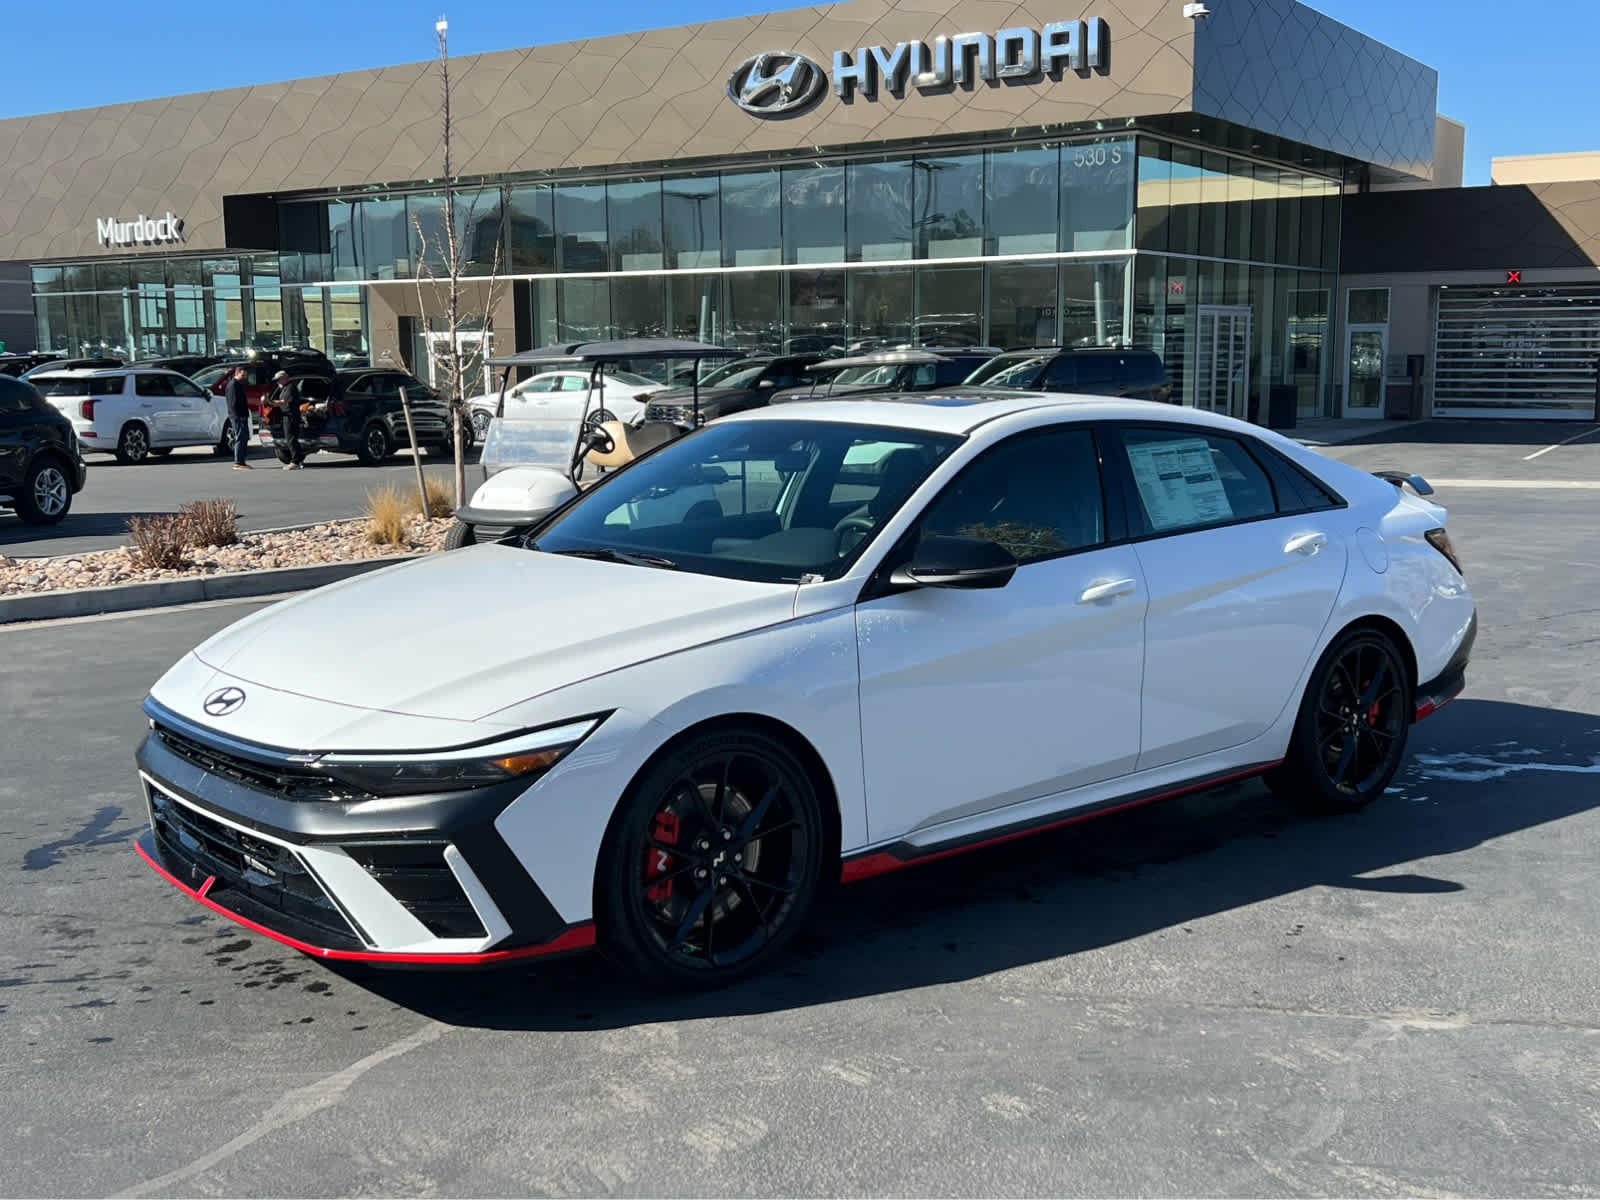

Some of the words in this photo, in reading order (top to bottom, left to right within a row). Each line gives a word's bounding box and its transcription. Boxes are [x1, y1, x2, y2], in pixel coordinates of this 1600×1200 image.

[833, 15, 1108, 102] HYUNDAI
[1074, 147, 1105, 168] 530
[1111, 145, 1121, 164] S
[96, 211, 181, 245] Murdock
